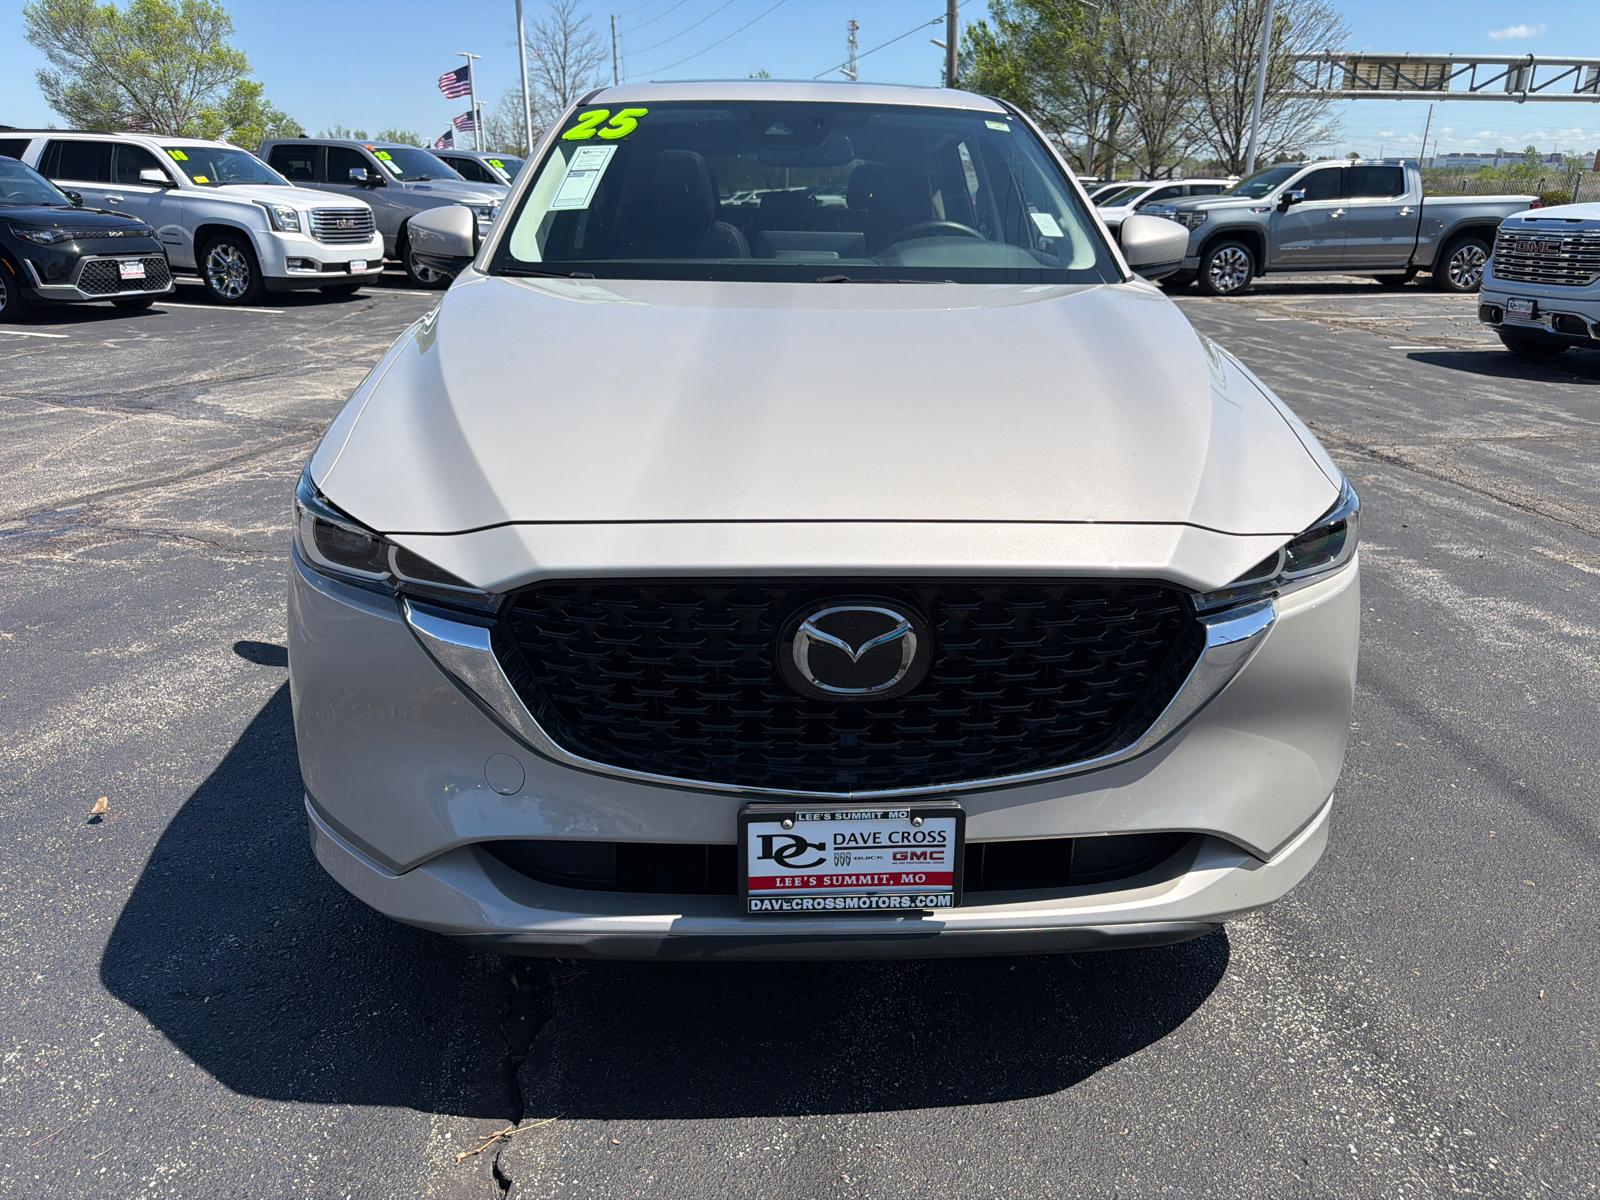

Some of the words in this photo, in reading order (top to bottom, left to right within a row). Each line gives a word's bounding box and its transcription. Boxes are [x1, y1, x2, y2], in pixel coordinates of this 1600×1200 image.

[562, 108, 649, 140] 25
[167, 150, 189, 161] 18
[1517, 241, 1560, 254] GMC
[798, 813, 831, 821] LEE'S
[835, 812, 883, 820] SUMMIT
[888, 811, 908, 819] MO
[833, 832, 882, 845] DAVE
[888, 830, 946, 844] CROSS
[892, 850, 945, 861] GMC
[775, 876, 817, 887] LEE'S
[823, 874, 894, 886] SUMMIT,
[900, 874, 926, 884] MO
[750, 895, 951, 911] DAVECROSSMOTORS.COM
